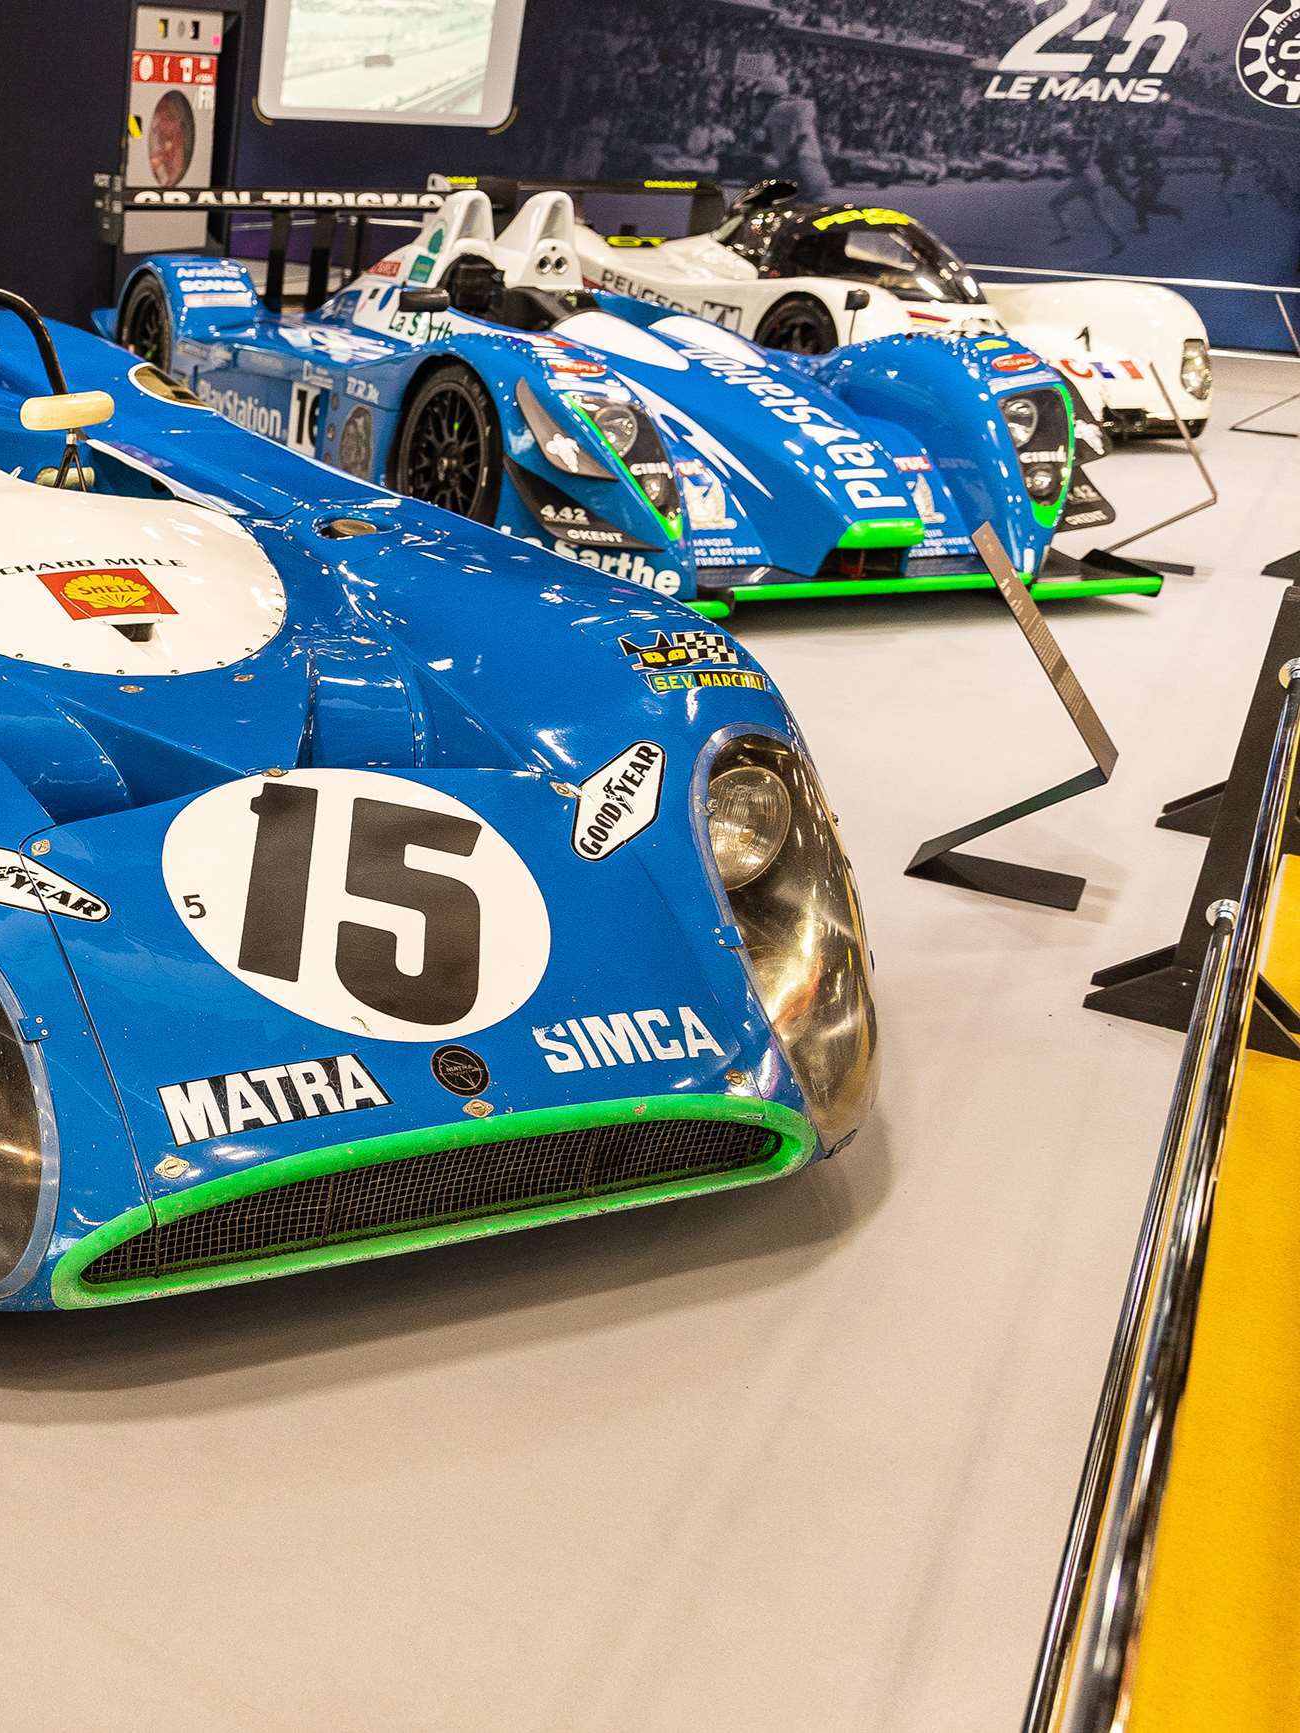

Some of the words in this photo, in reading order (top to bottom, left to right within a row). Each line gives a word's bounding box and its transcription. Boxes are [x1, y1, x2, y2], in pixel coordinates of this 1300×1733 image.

[984, 75, 1040, 100] LE
[104, 557, 188, 568] MILLE
[77, 583, 140, 596] SHELL
[700, 673, 763, 691] MARCHAL
[581, 744, 659, 857] GOODYEAR
[184, 894, 207, 919] 5
[237, 782, 482, 1026] 15
[532, 1006, 725, 1074] SIMCA
[160, 1056, 390, 1146] MATRA
